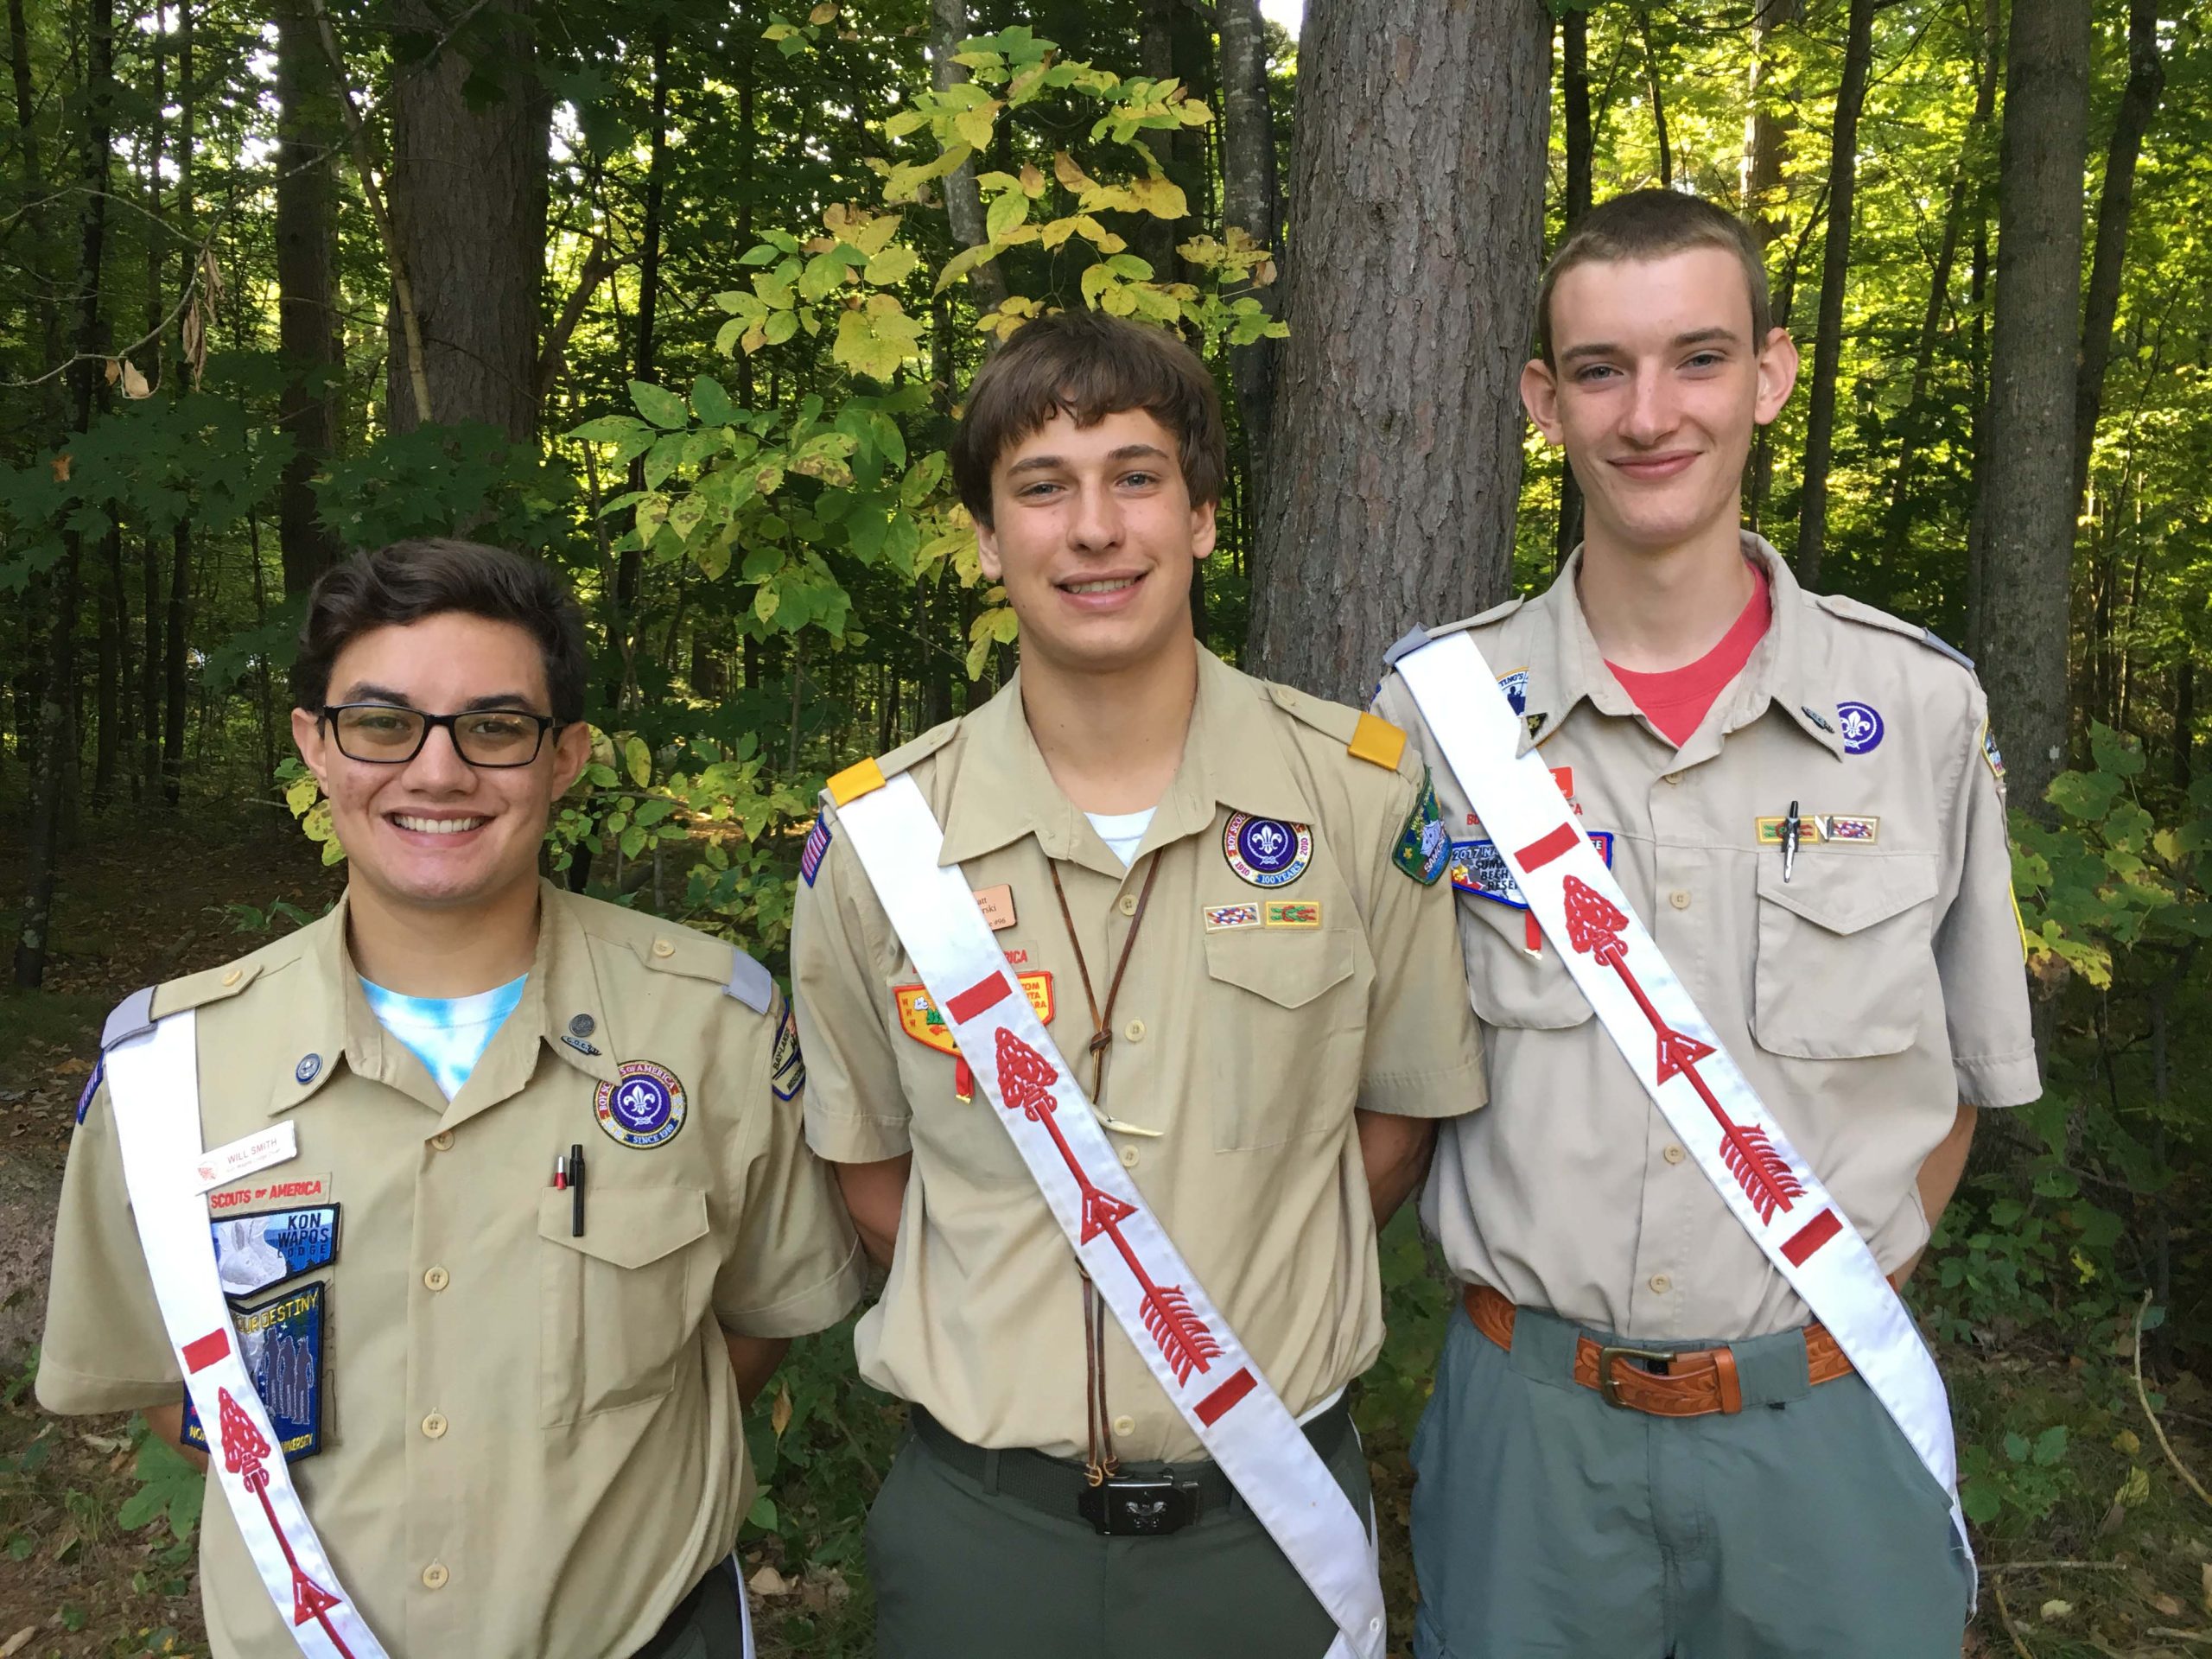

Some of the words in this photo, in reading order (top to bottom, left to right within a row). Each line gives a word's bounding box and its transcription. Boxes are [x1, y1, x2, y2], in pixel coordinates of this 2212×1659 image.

[1497, 673, 1524, 687] TING'S
[1230, 814, 1246, 834] SCOU
[1228, 833, 1236, 851] BOY
[1300, 837, 1309, 855] 2010
[1452, 849, 1480, 861] 2017
[1235, 861, 1250, 876] 1910
[1275, 864, 1301, 882] YEARS
[1480, 870, 1509, 880] BECH
[1487, 880, 1518, 891] RESE
[977, 897, 988, 906] att
[982, 906, 997, 915] rski
[1004, 950, 1028, 964] RICA
[598, 1092, 607, 1111] BOY
[636, 1065, 676, 1089] AMERICA
[633, 1133, 659, 1144] SINCE
[659, 1123, 674, 1139] 1910
[227, 1150, 249, 1165] WILL
[251, 1138, 277, 1155] SMITH
[210, 1189, 252, 1209] SCOUTS
[254, 1189, 268, 1199] OF
[268, 1180, 322, 1200] AMERICA
[288, 1212, 321, 1230] KON
[277, 1228, 329, 1248] WAPOS
[277, 1244, 326, 1258] LODGE
[234, 1314, 258, 1335] OUR
[260, 1287, 319, 1328] DESTINY
[281, 1433, 313, 1454] NIVERSITY
